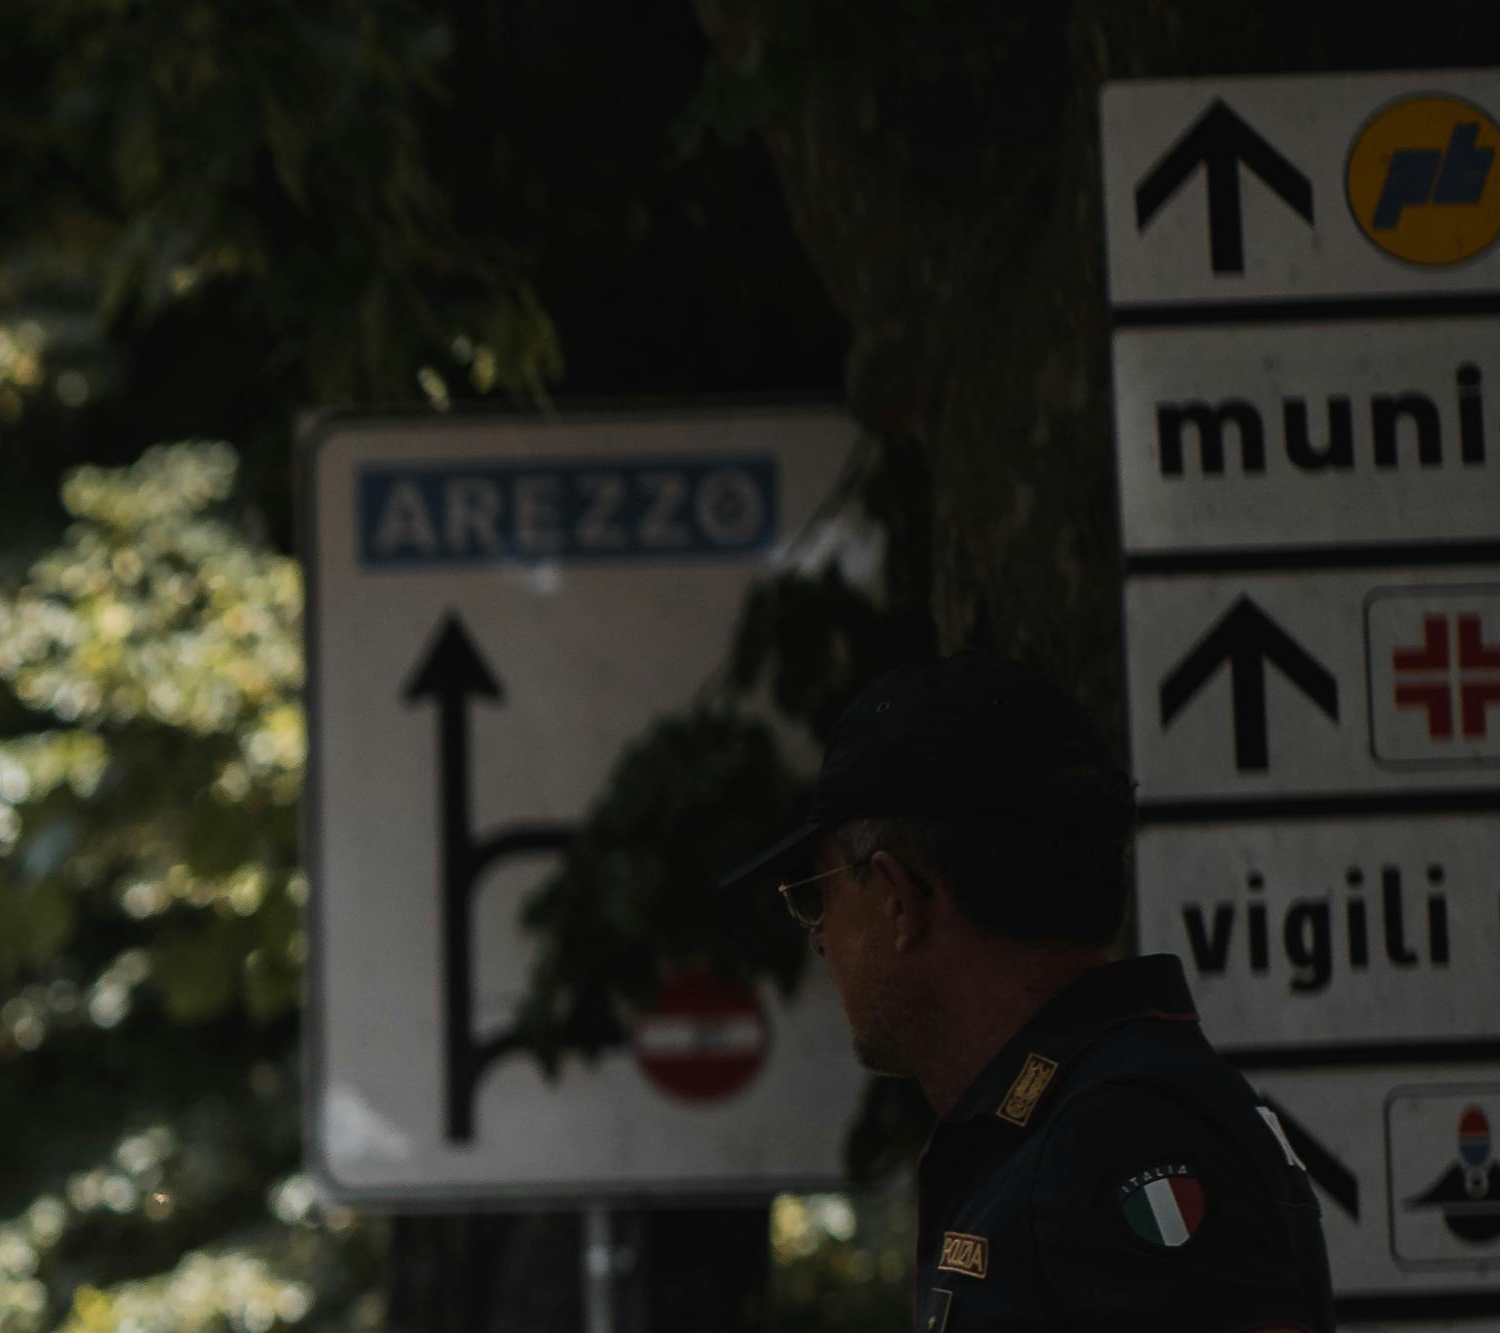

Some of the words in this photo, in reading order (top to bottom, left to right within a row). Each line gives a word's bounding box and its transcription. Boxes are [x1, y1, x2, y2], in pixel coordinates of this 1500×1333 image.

[1154, 360, 1487, 478] muni
[375, 467, 765, 556] AREZZO
[1181, 862, 1450, 992] vigili
[1120, 1163, 1189, 1194] ITALIA
